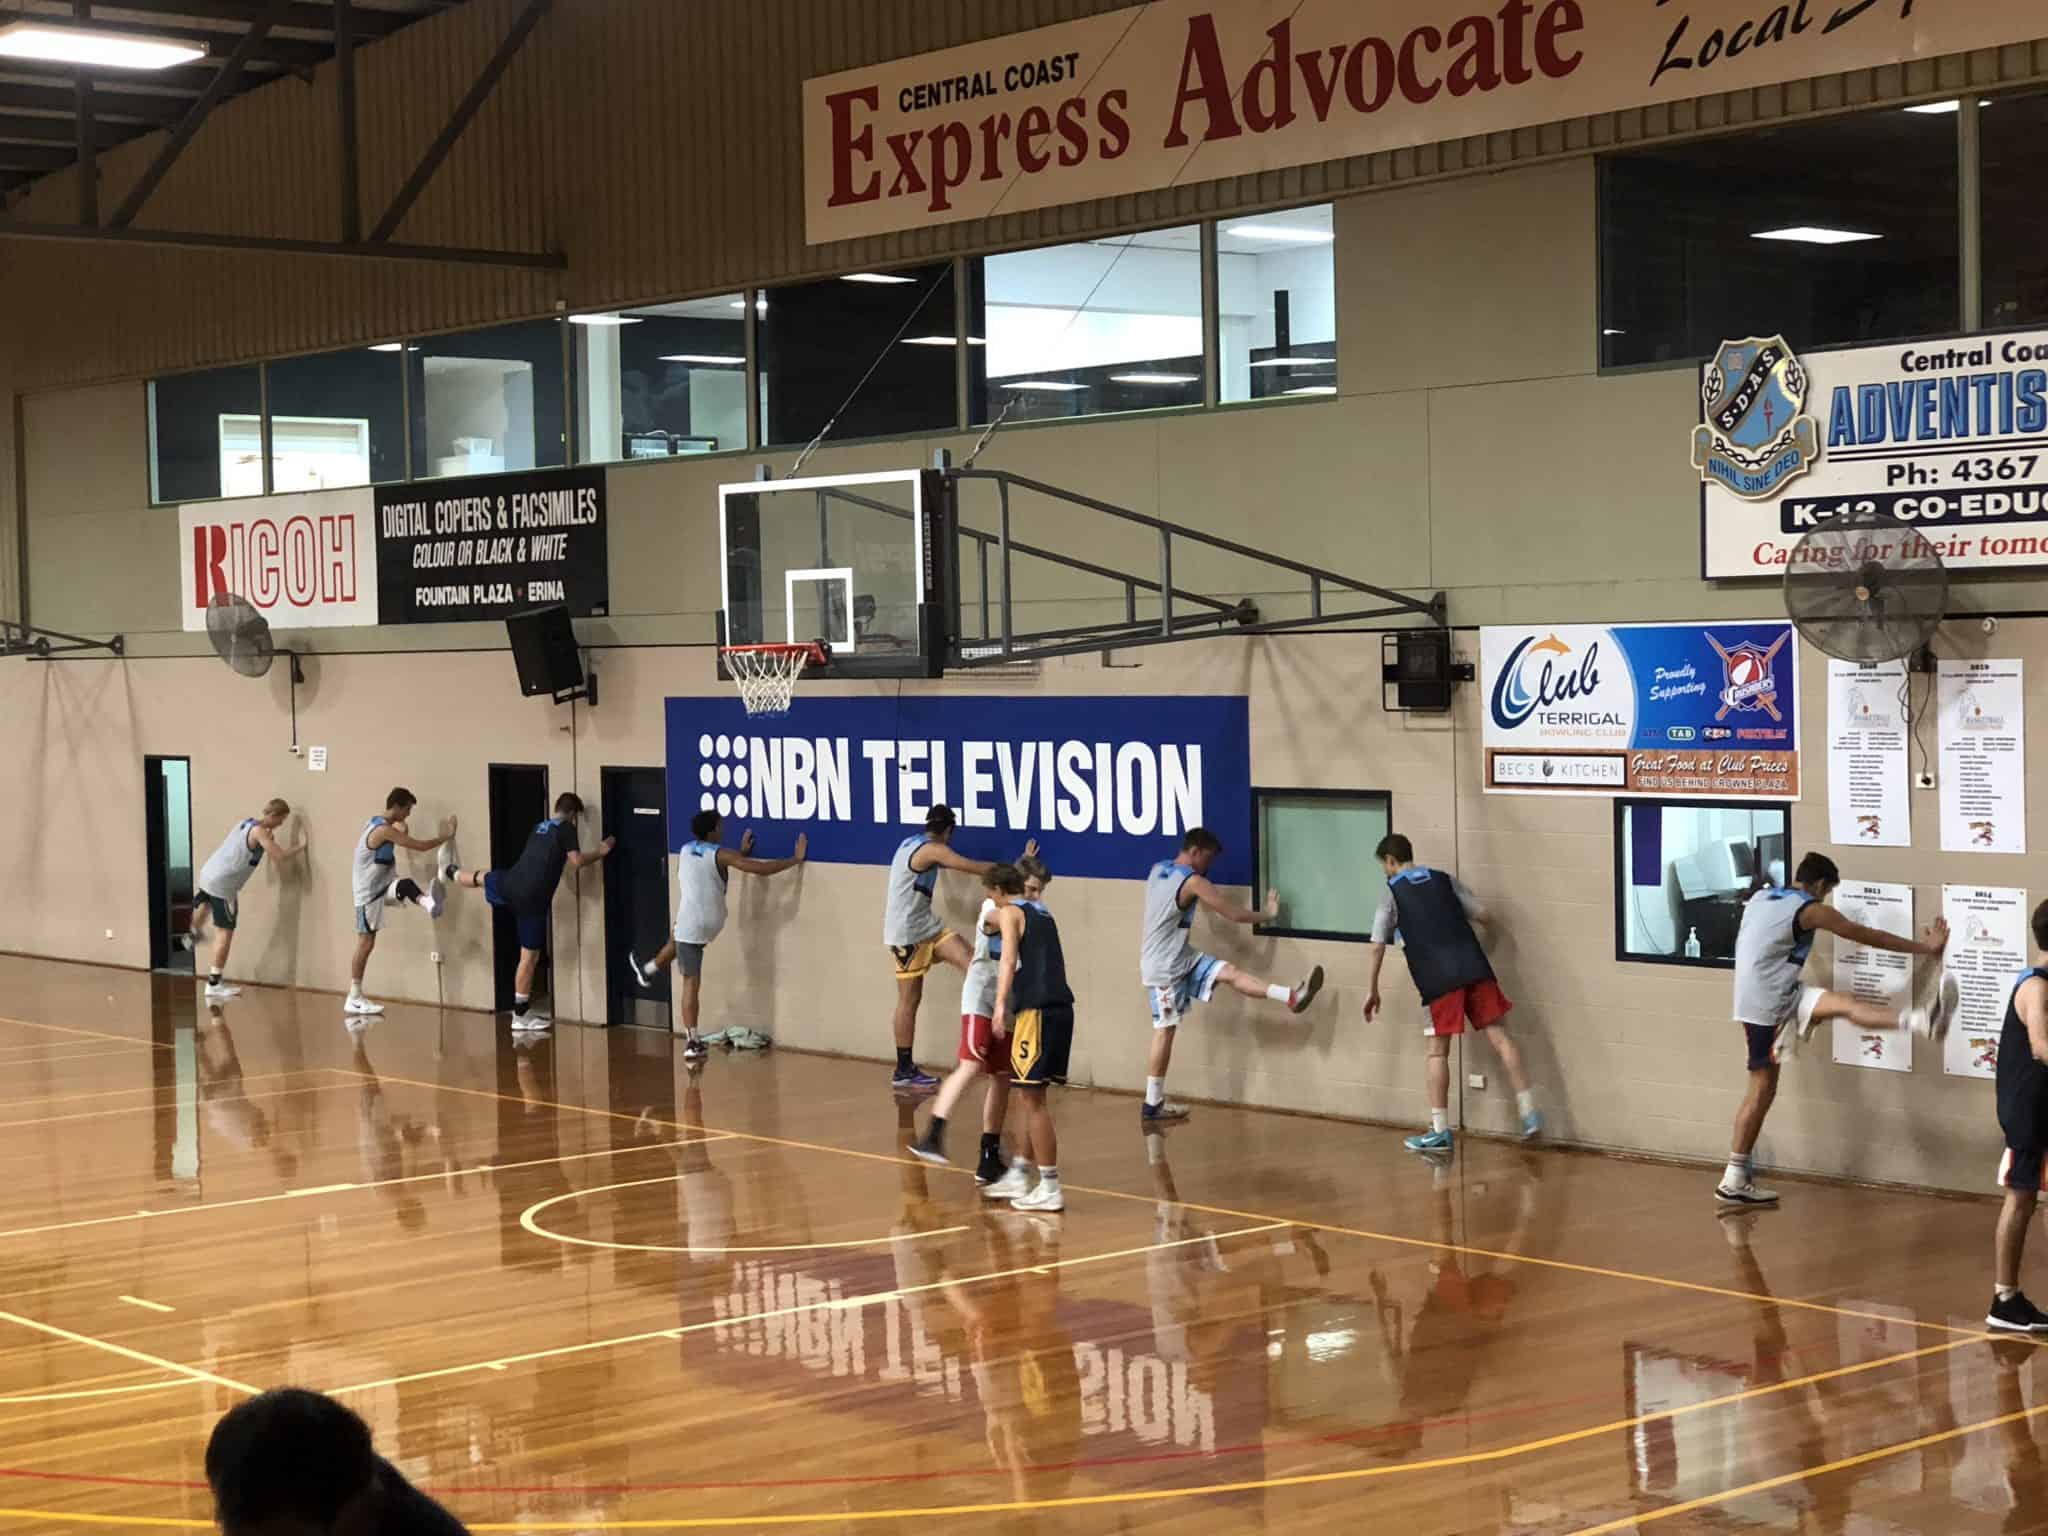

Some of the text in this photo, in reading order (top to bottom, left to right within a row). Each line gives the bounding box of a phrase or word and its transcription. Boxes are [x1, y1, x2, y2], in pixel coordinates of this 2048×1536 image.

[899, 52, 1079, 113] CENTRAL COAST
[825, 0, 1584, 212] Express Advocate
[1901, 341, 1992, 372] Central
[1827, 369, 2047, 447] ADVENTIS
[1708, 450, 1800, 491] NIHIL SINE DEO
[1887, 455, 2039, 487] Ph: 4367
[382, 488, 597, 538] DIGITAL COPIERS & FACSIMILES
[1793, 501, 1876, 526] K-12
[193, 514, 357, 608] RICOH
[413, 533, 568, 568] COLOUR OR BLACK & WHITE
[1753, 538, 1844, 567] Caring
[1852, 537, 1893, 561] for
[1901, 534, 1972, 560] their
[416, 581, 565, 608] FOUNTAIN PLAZA ERINA
[1491, 636, 1600, 730] Club
[1655, 664, 1697, 683] Proudly
[1650, 682, 1707, 702] Supporting
[1538, 712, 1626, 726] TERRIGAL
[1499, 762, 1618, 777] BEC'S KITCHEN
[1632, 753, 1789, 775] Great Food at Club Prices
[751, 737, 1202, 837] NBN TELEVISION
[1019, 1040, 1029, 1059] S
